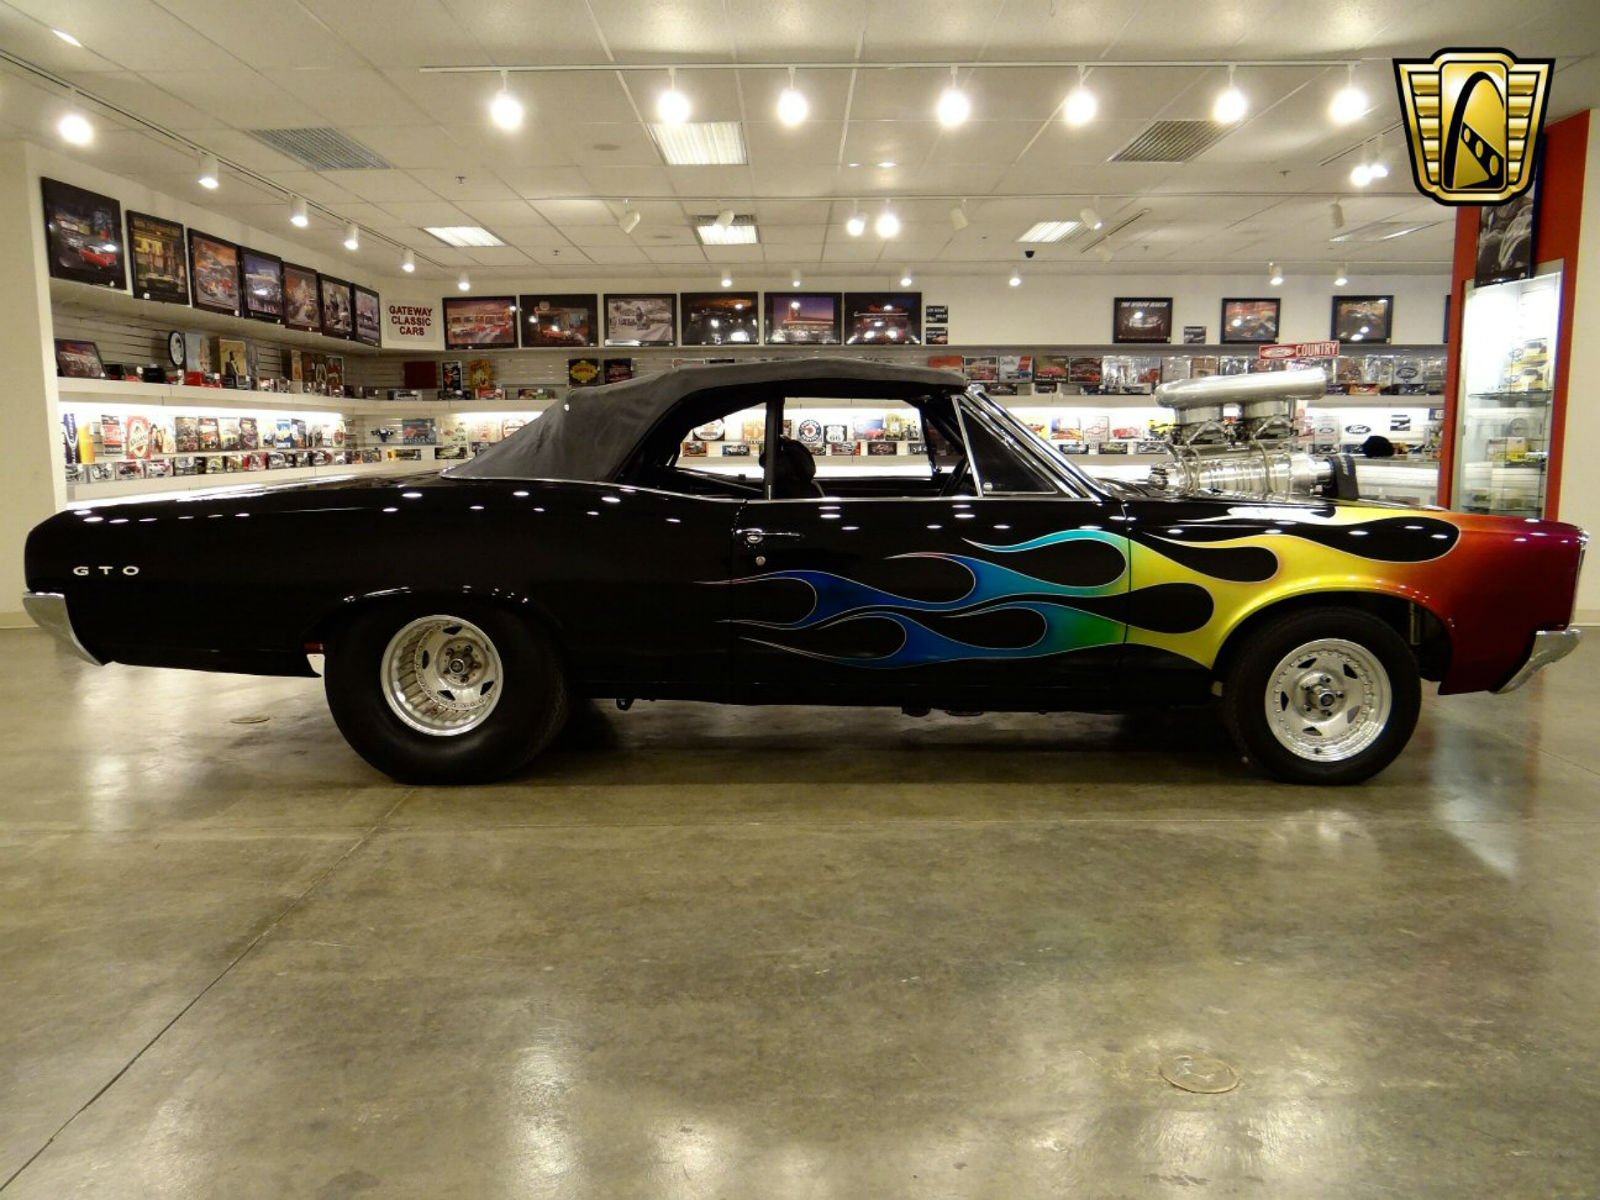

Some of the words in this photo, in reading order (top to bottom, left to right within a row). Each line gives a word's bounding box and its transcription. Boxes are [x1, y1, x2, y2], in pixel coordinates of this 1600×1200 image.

[388, 305, 433, 317] GATEWAY
[391, 316, 432, 327] CLASSIC
[399, 326, 425, 336] CARS
[1296, 343, 1337, 357] COUNTRY
[73, 566, 140, 576] GTO
